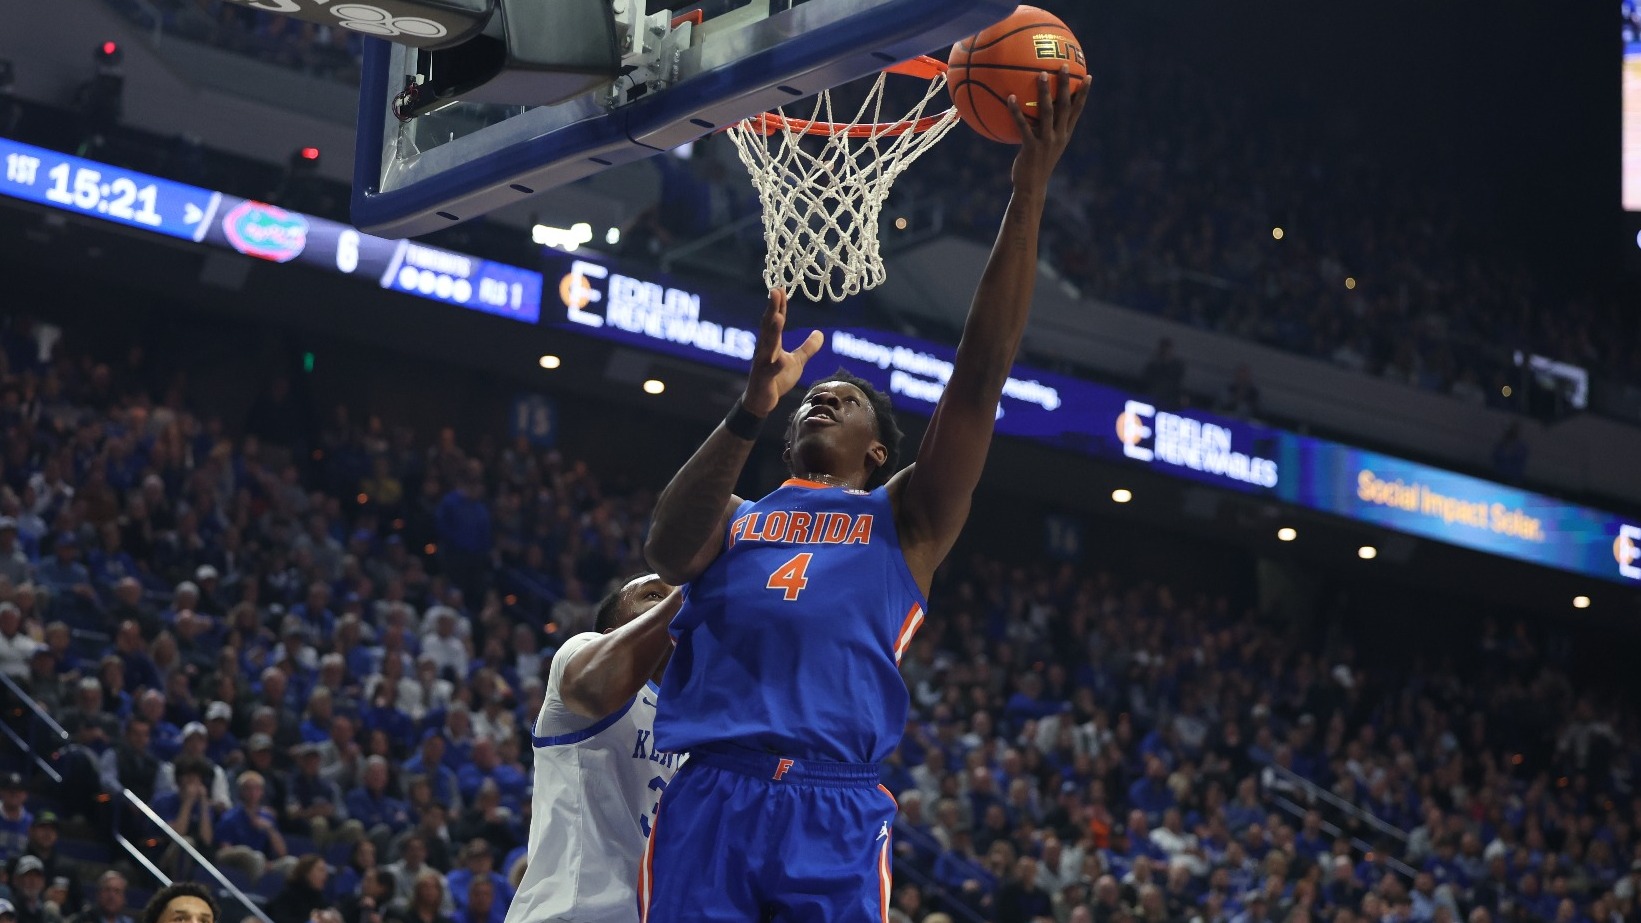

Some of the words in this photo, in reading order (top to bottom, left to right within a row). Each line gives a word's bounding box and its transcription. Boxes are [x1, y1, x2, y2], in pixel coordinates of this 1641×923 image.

[7, 153, 40, 185] 1ST
[46, 162, 162, 226] 15:21
[336, 229, 359, 273] 6
[608, 274, 700, 320] EDELEN
[606, 302, 756, 360] RENEWABLES
[1155, 411, 1231, 455] EDELEN
[1154, 435, 1278, 488] RENEWABLES
[1358, 470, 1419, 512] Social
[1420, 484, 1489, 529] Impact
[729, 510, 874, 550] FLORIDA
[766, 553, 813, 601] 4
[772, 758, 794, 780] F
